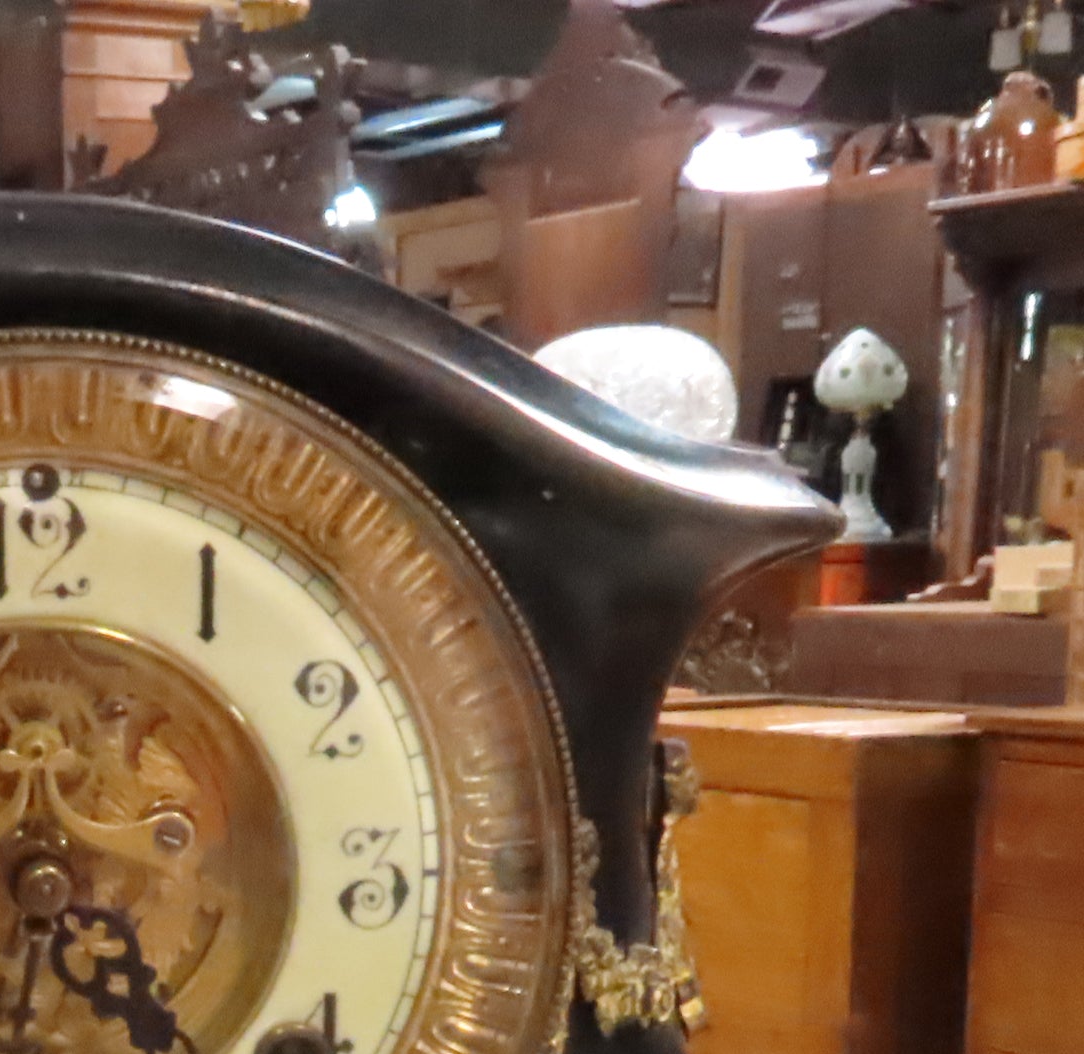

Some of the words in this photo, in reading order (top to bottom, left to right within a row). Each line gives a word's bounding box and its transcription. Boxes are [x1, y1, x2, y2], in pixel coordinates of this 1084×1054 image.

[198, 542, 216, 643] 1
[294, 658, 364, 759] 2
[338, 828, 410, 930] 3
